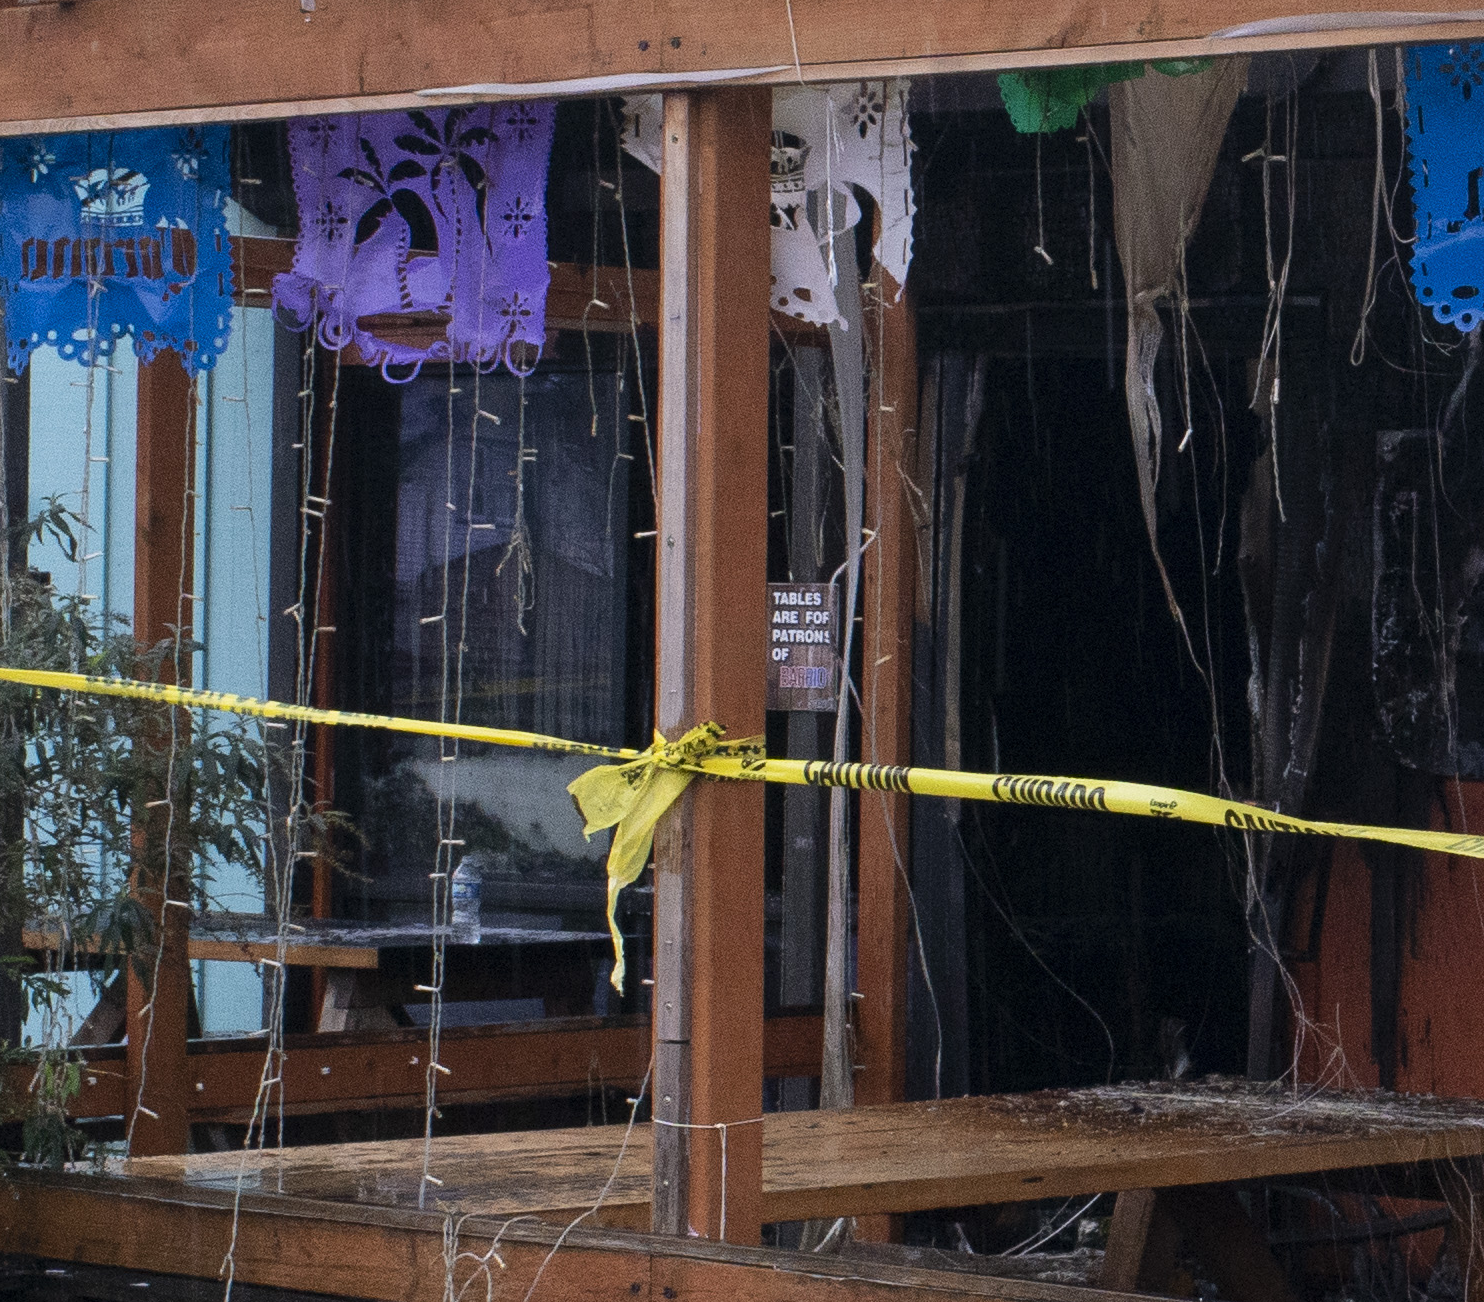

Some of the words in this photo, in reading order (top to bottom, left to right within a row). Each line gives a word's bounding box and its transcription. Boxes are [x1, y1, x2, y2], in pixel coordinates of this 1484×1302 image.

[772, 592, 821, 606] TABLES
[772, 611, 798, 624] ARE
[772, 648, 789, 661] OF
[779, 666, 826, 689] BARRIO
[803, 760, 914, 795] CAUTION
[992, 776, 1109, 812] CUIDADO
